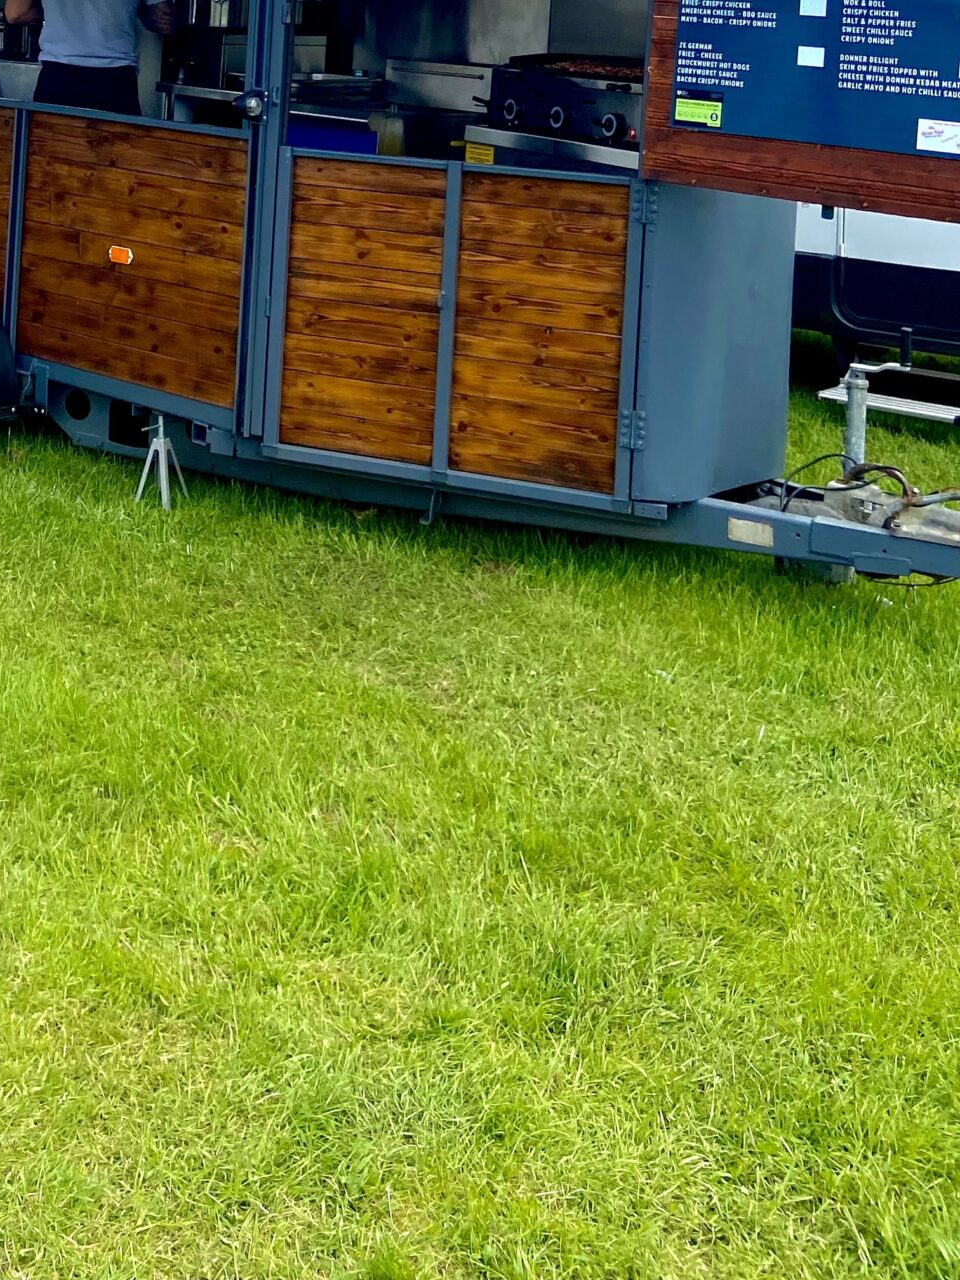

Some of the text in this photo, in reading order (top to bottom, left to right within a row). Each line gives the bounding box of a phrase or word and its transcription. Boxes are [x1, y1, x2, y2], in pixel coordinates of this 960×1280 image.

[702, 0, 723, 8] CRISPY
[869, 0, 886, 8] ROLL
[742, 10, 755, 18] BBQ
[842, 8, 899, 17] CRISPY CHICKEN
[703, 17, 723, 25] BACON
[842, 17, 859, 25] SALT
[896, 20, 917, 28] FRIES
[890, 29, 913, 37] SAUCE
[841, 35, 894, 45] CRISPY ONIONS
[688, 42, 712, 50] GERMAN
[678, 50, 695, 58] FRIES
[701, 52, 723, 60] CHEESE
[840, 54, 899, 65] DONNER DELIGHT
[678, 59, 750, 71] BROCKWURST HOT DOGS
[677, 67, 717, 76] CURRYWURST
[890, 67, 918, 76] TOPPED
[721, 80, 744, 88] ONIONS
[839, 73, 864, 81] CHEESE
[885, 76, 914, 85] DONNER
[916, 78, 940, 87] KEBAB
[838, 82, 863, 90] GARLIC
[864, 84, 884, 92] MAYO
[902, 87, 916, 95] HOT
[918, 88, 941, 97] CHILLI
